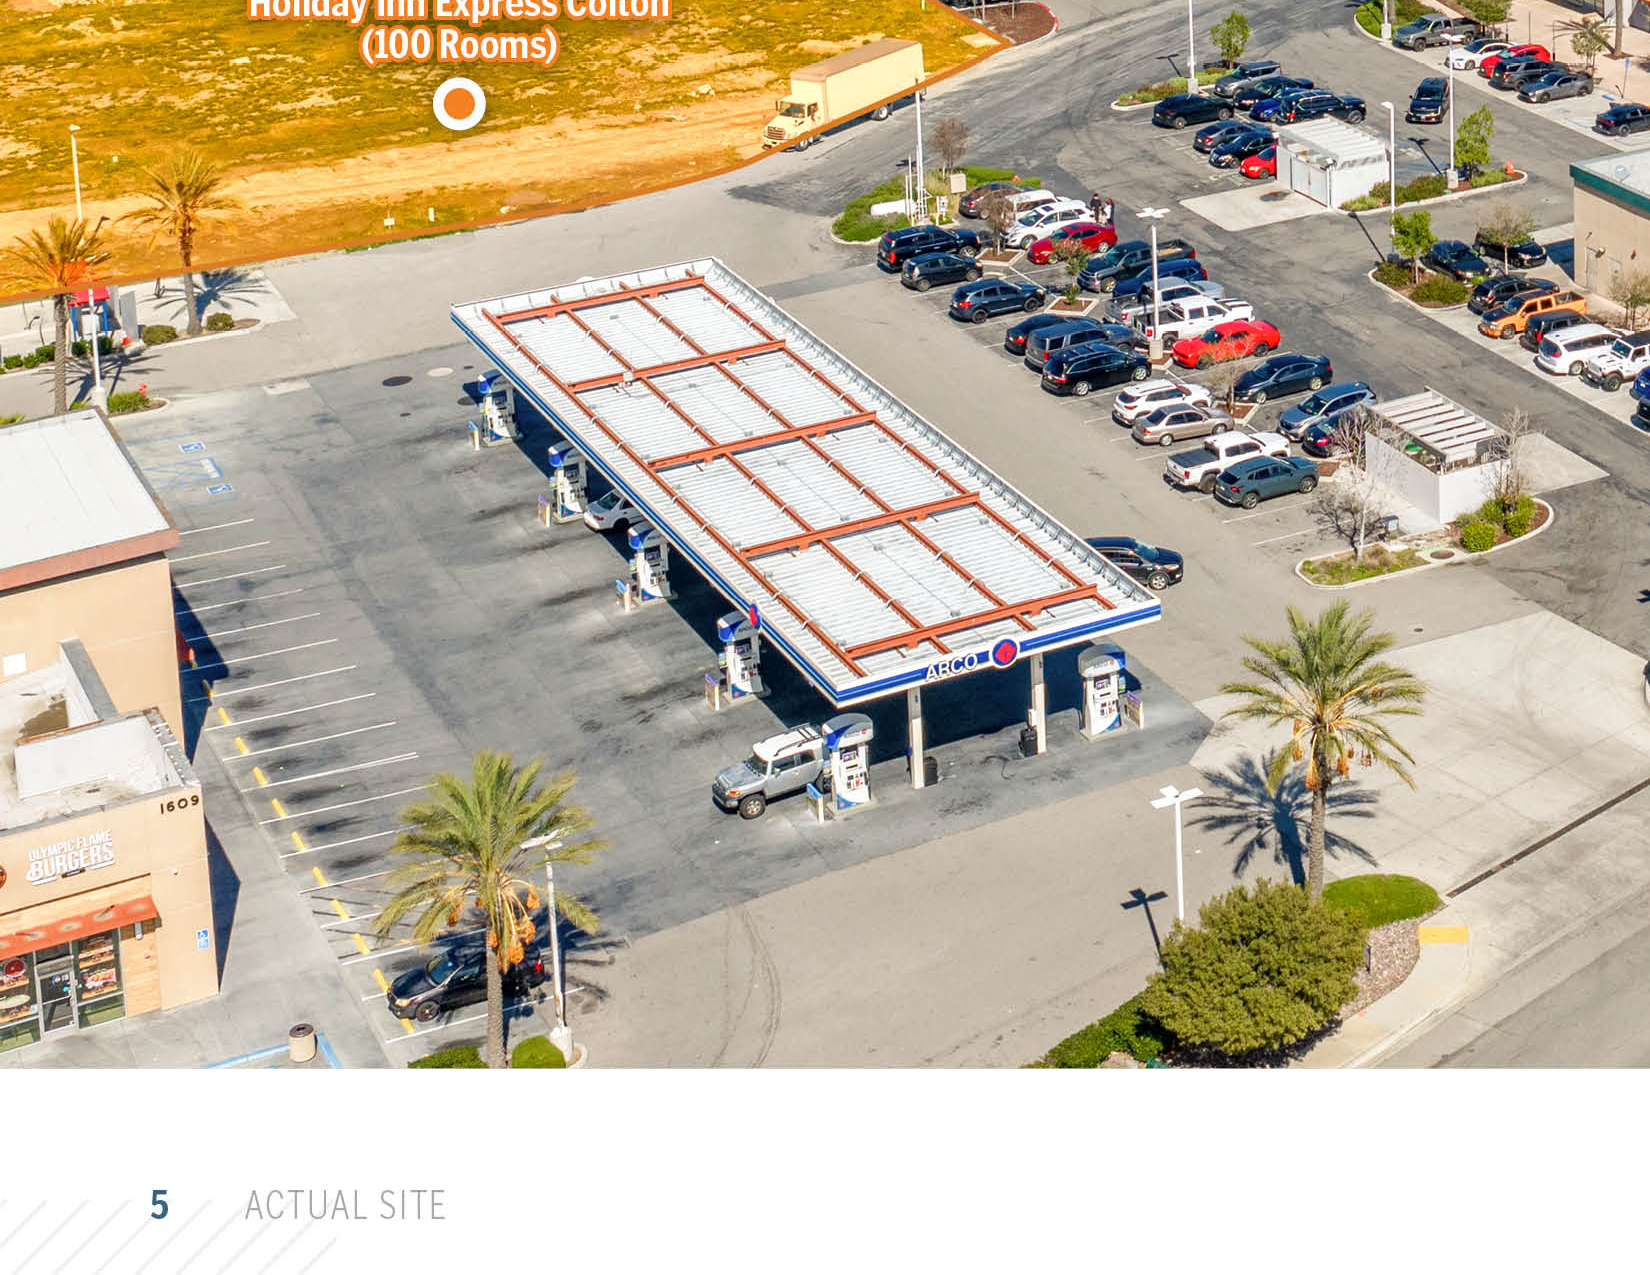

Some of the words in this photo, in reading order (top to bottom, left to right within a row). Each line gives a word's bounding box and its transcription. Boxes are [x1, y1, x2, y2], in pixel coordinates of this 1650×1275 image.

[925, 653, 978, 682] ARCO
[160, 795, 199, 814] 1609
[28, 839, 75, 862] OLYMPIC
[76, 829, 113, 849] FLAME
[26, 842, 115, 882] BURGERS
